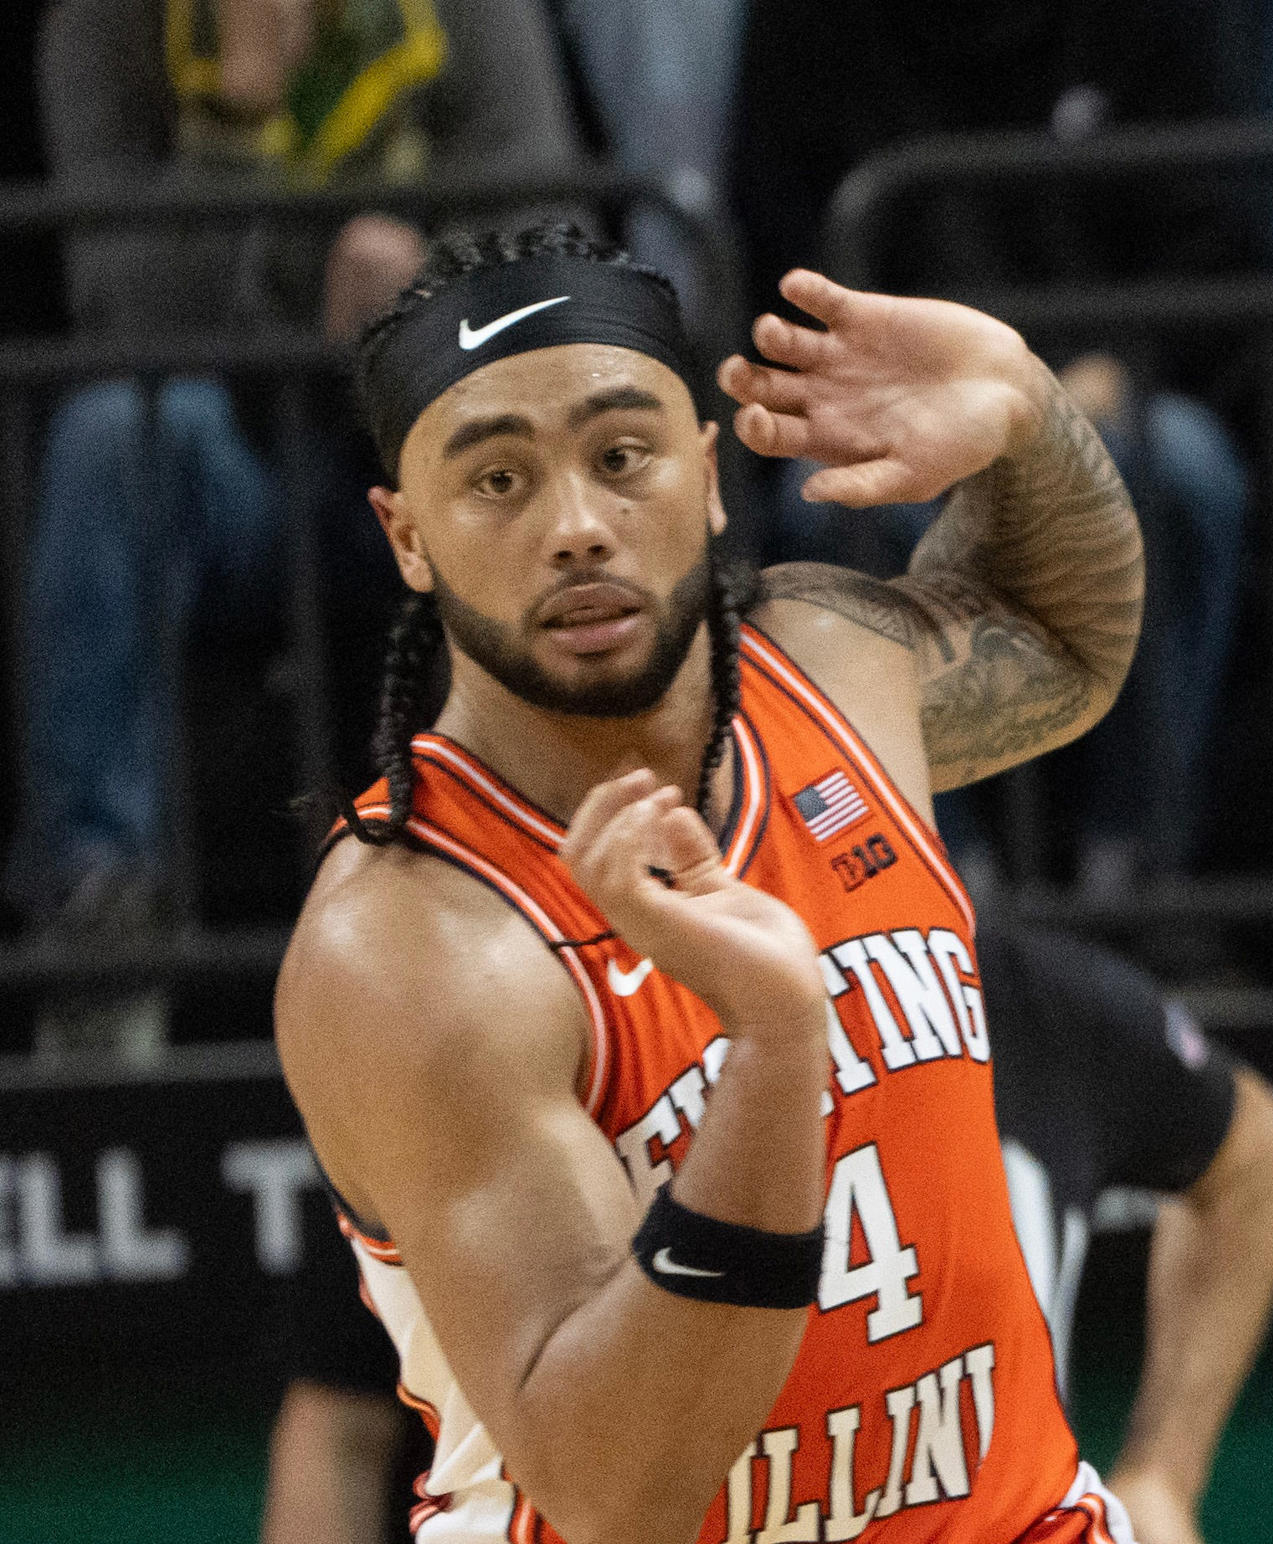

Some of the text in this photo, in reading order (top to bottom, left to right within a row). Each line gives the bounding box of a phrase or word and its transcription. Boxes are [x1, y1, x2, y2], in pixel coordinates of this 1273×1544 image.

[615, 926, 993, 1200] FTING
[0, 1147, 190, 1284] LL
[817, 1140, 923, 1345] 4
